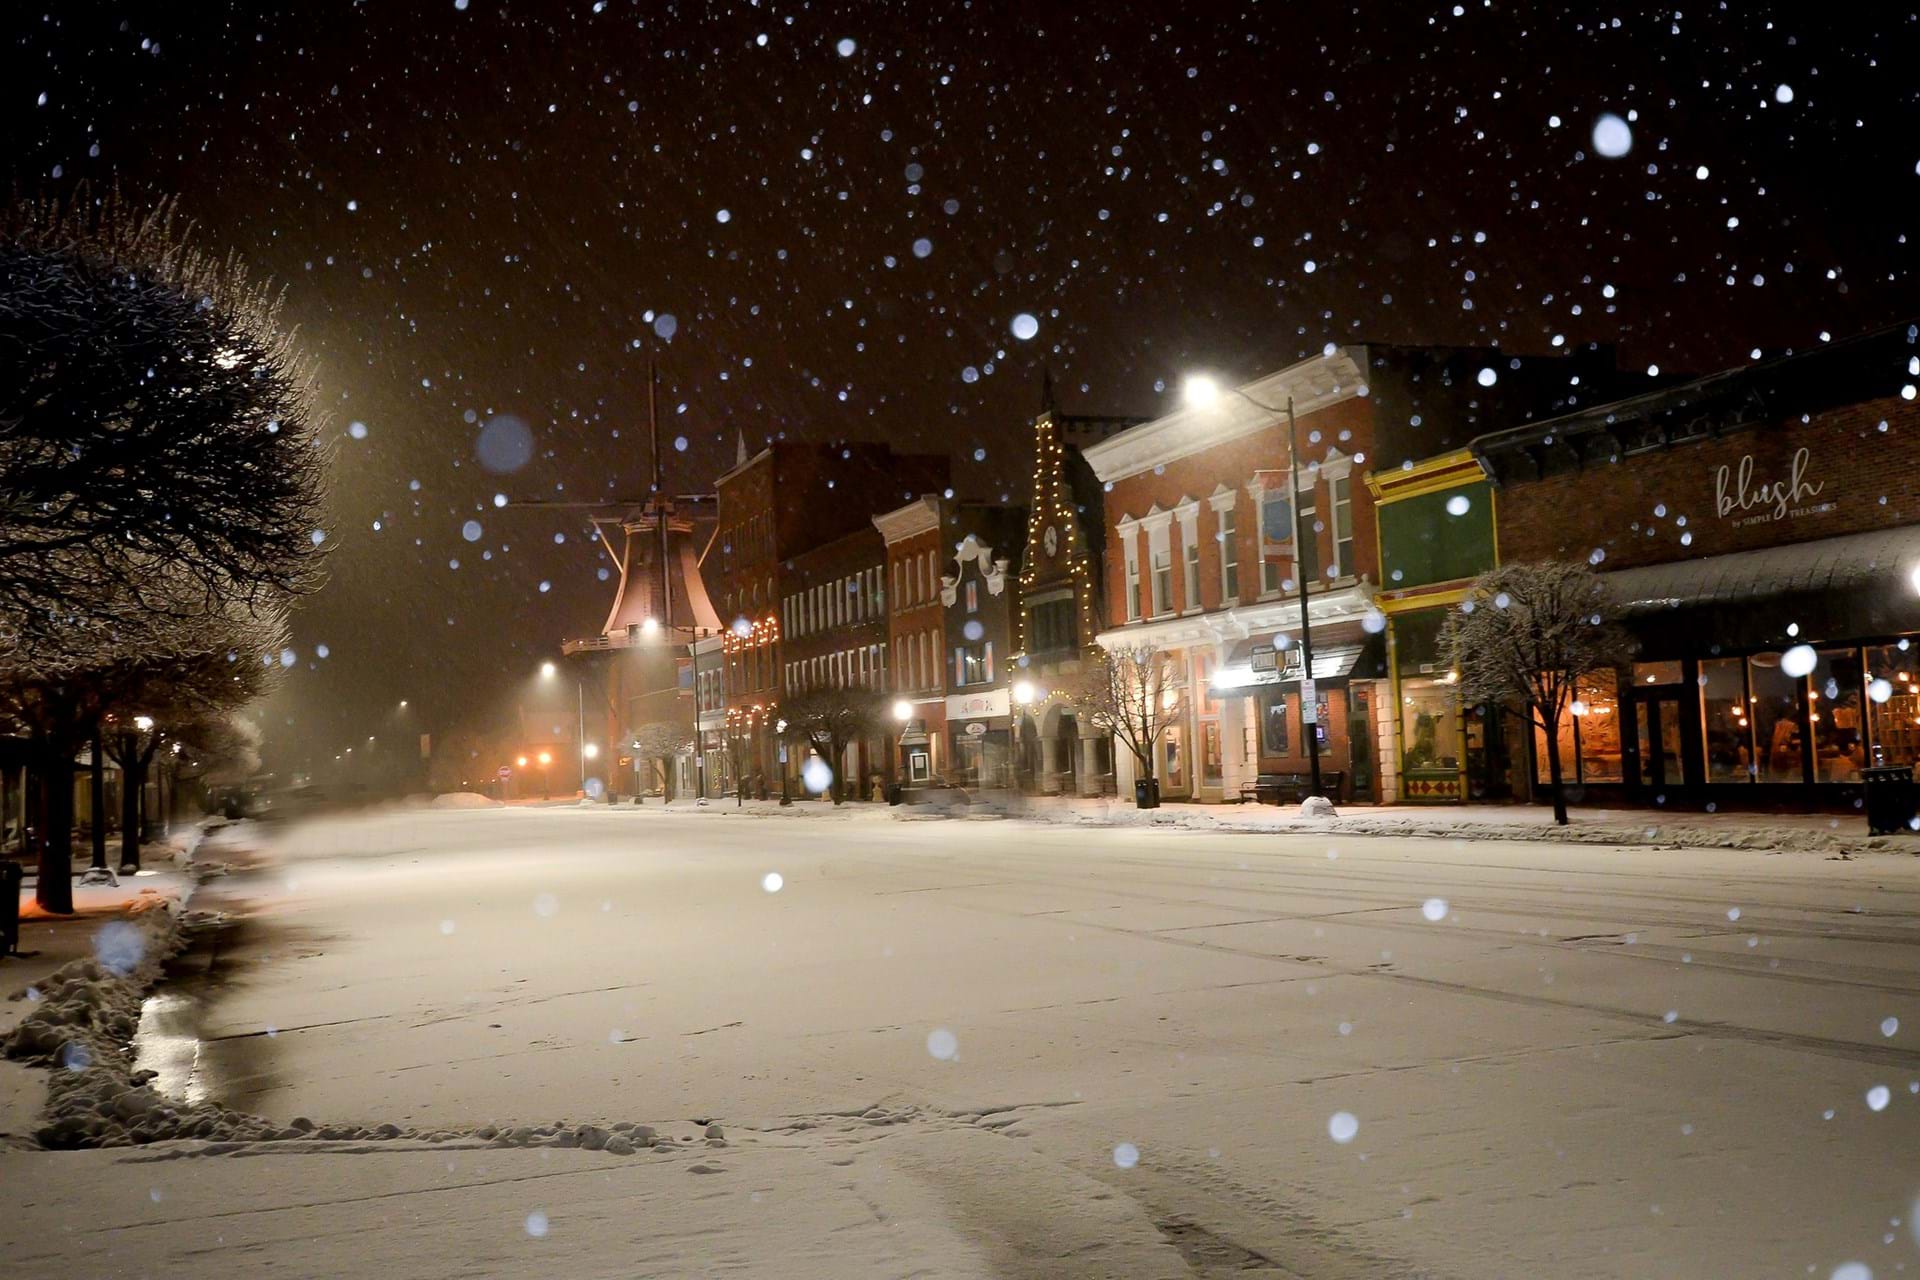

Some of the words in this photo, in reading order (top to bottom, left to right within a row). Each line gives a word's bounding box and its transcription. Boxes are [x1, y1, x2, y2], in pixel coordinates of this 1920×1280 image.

[1716, 447, 1824, 520] blush
[1743, 514, 1771, 526] SIMPLE
[1789, 503, 1837, 518] TREASUES
